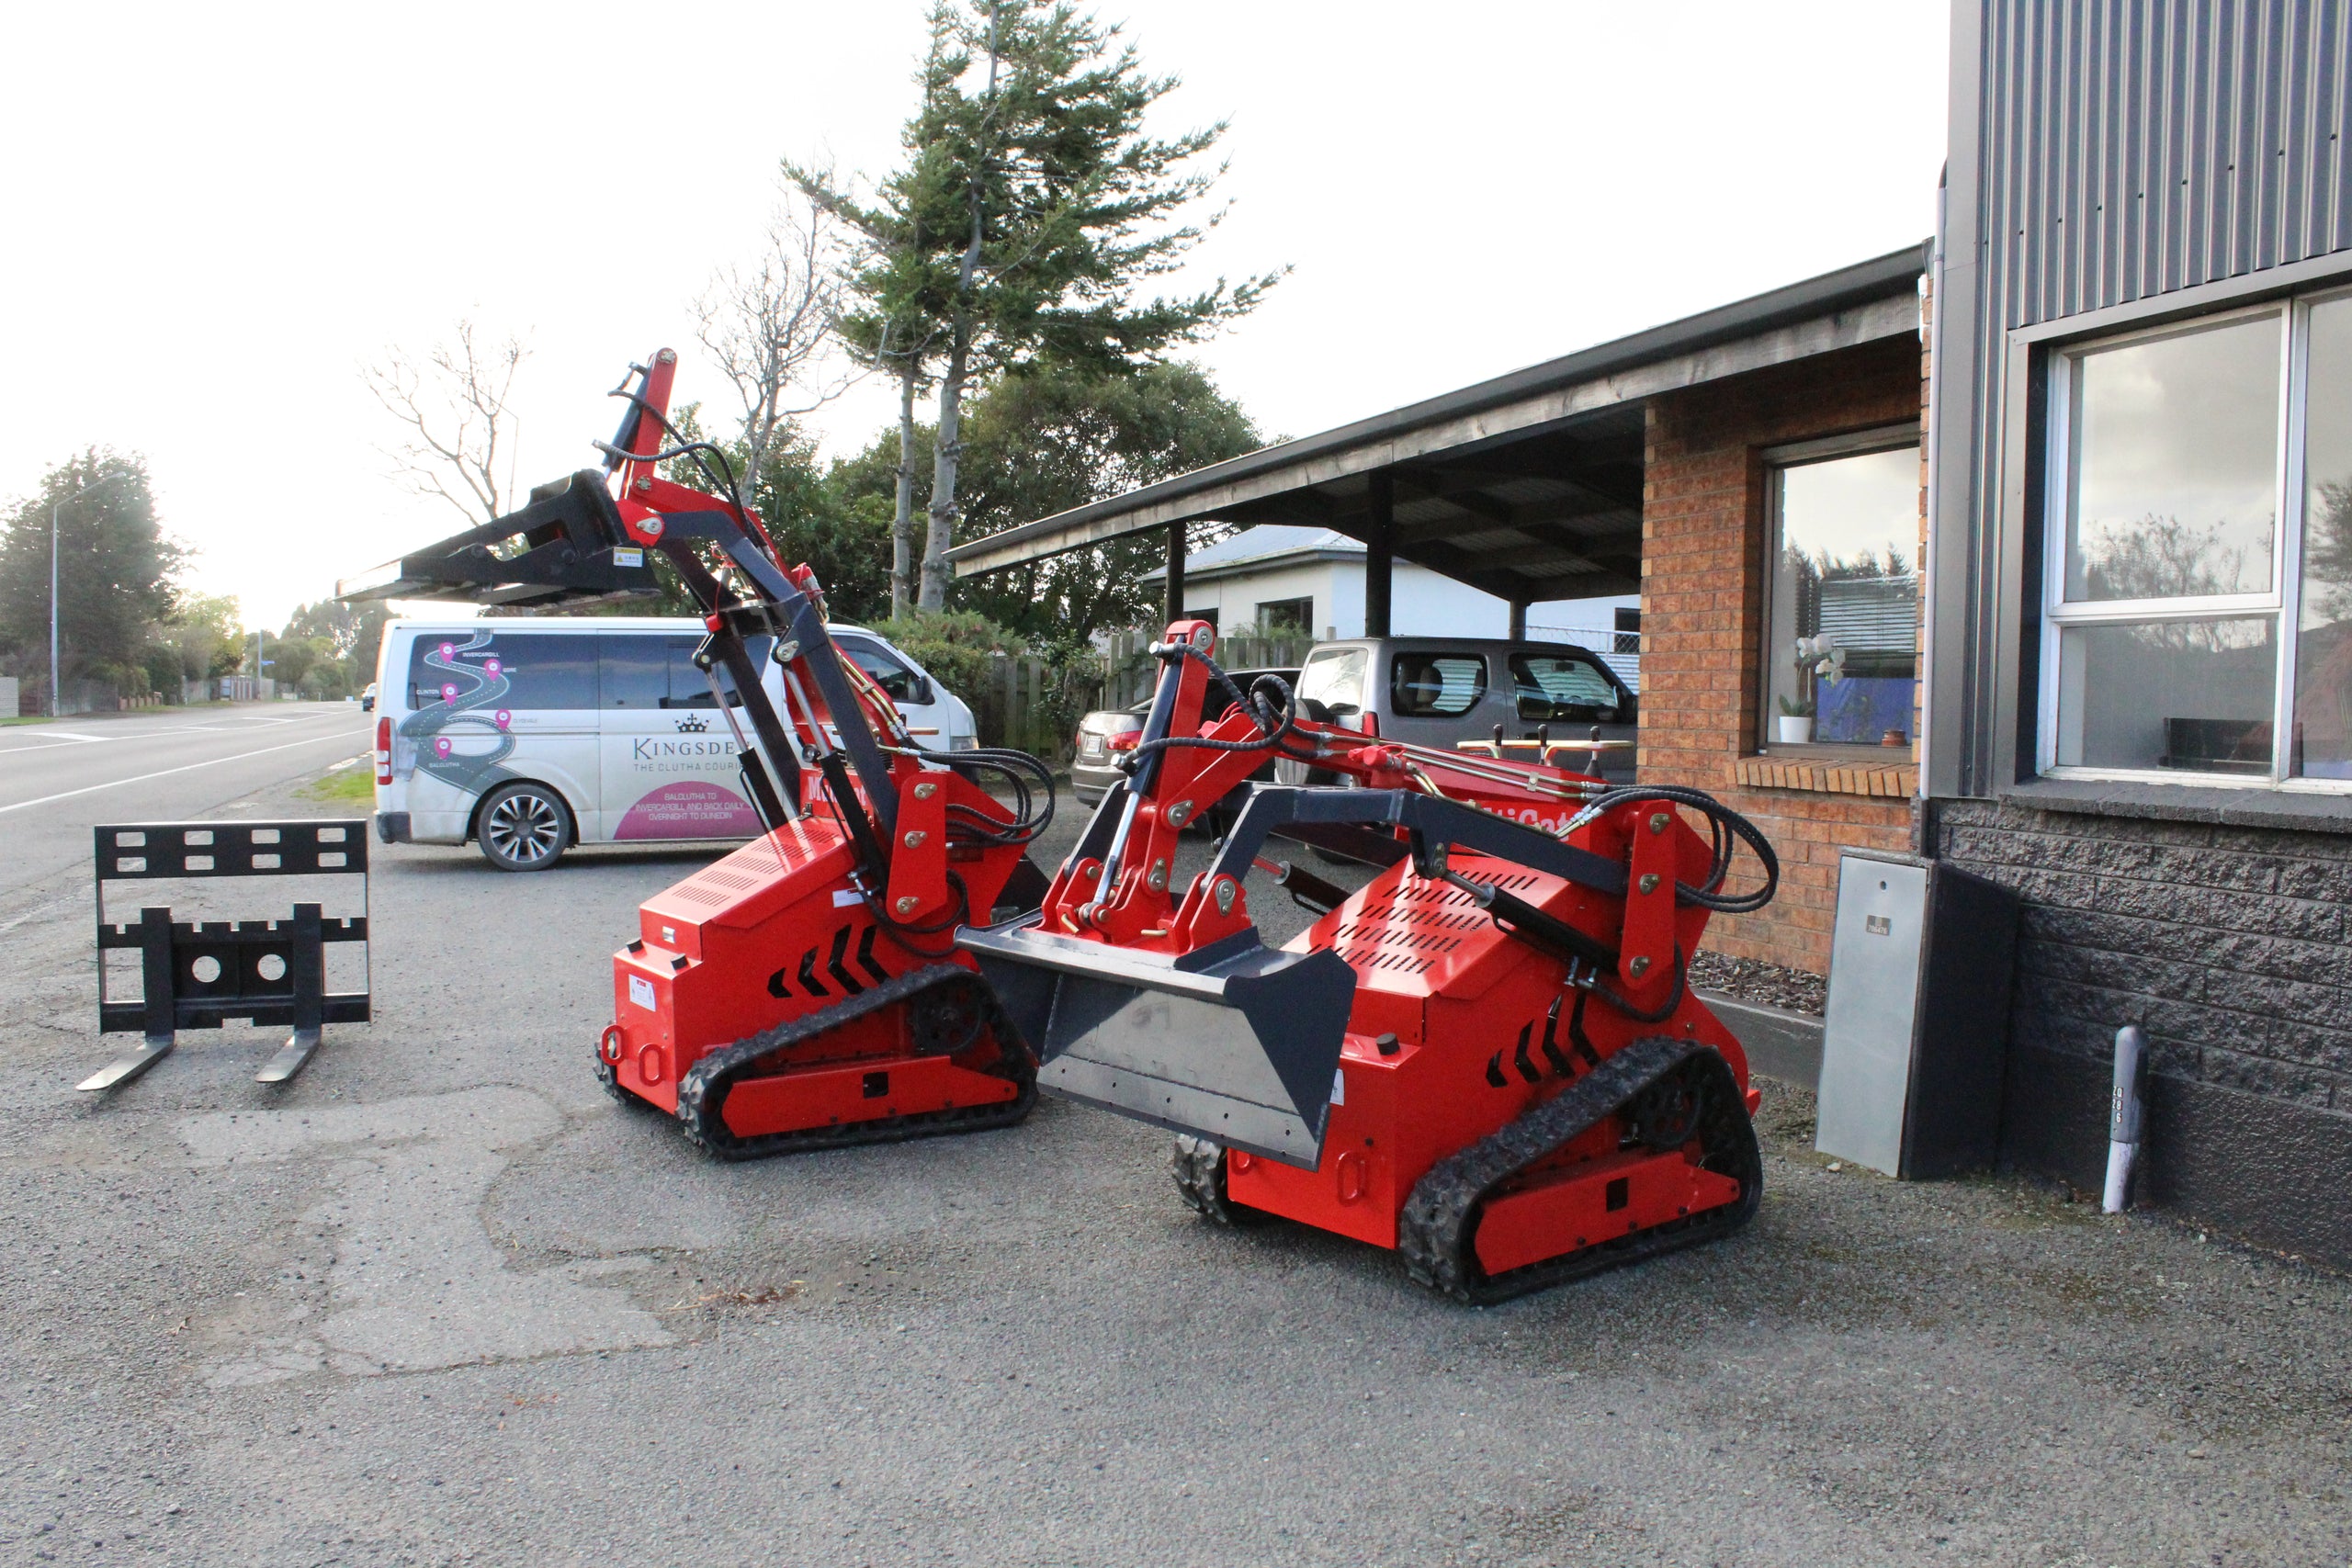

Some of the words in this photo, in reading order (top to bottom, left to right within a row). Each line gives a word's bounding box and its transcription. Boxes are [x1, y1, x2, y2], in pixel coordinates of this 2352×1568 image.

[634, 738, 751, 760] KINGSDE
[634, 763, 654, 772] THE
[658, 762, 701, 772] CLUTHA
[664, 793, 706, 801] BALCLUTHA
[707, 792, 717, 800] TO
[636, 802, 685, 811] INVERCARGILL
[687, 802, 703, 810] AND
[705, 802, 723, 810] BACK
[724, 801, 745, 810] DAILY
[649, 812, 688, 821] OVERNIGHT
[700, 811, 733, 819] DUNEDIN
[2116, 1112, 2121, 1123] 6
